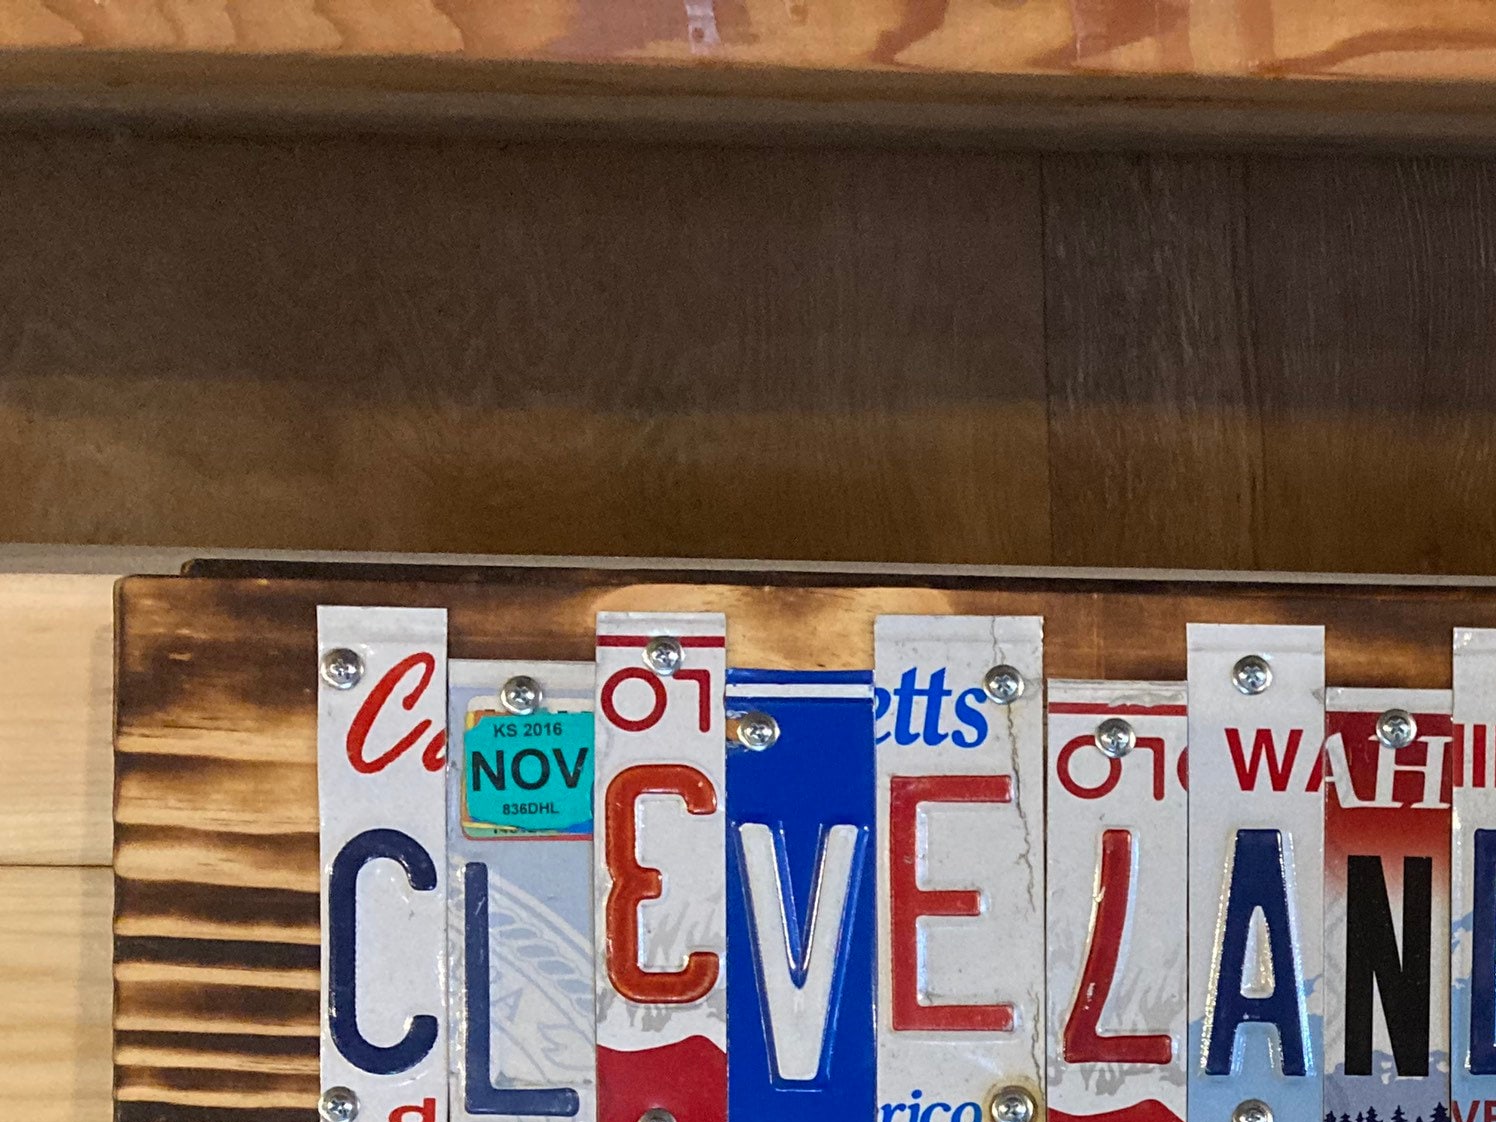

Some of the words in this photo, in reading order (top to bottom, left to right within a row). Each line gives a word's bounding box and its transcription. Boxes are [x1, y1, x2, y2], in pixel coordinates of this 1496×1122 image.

[494, 723, 517, 737] KS
[523, 722, 562, 736] 2016
[472, 747, 589, 791] NOV
[502, 802, 559, 815] 836DHL
